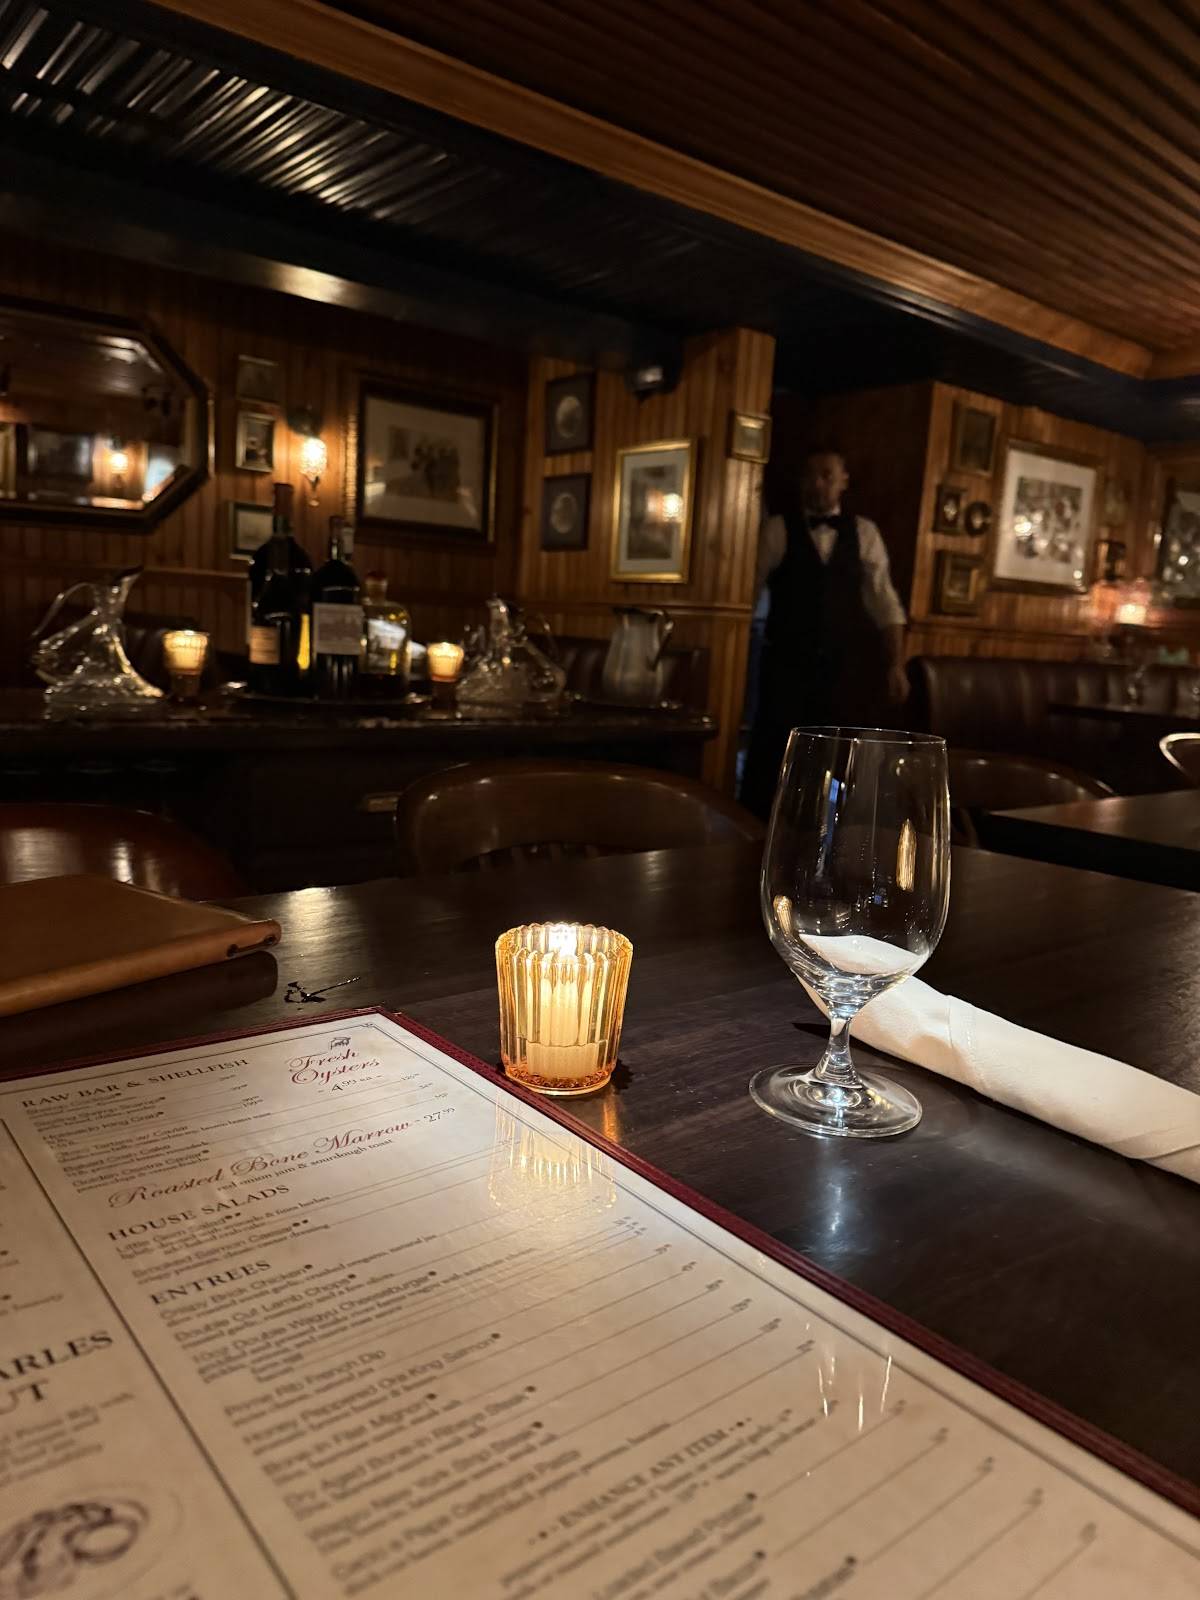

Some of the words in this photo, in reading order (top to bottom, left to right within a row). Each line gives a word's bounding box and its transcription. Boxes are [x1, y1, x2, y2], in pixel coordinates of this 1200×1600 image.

[285, 1047, 360, 1074] Fresh
[290, 1058, 381, 1086] Oysters
[21, 1092, 71, 1109] RAW
[77, 1083, 120, 1097] BAR
[126, 1079, 145, 1088] &
[148, 1059, 248, 1083] SHELLFISH
[108, 1168, 223, 1208] Roasted
[231, 1150, 309, 1177] Bone
[312, 1122, 410, 1155] Marrow
[108, 1211, 197, 1241] HOUSE
[201, 1184, 291, 1214] SALADS
[150, 1259, 272, 1305] ENTREES
[358, 1350, 386, 1365] Dip
[407, 1360, 444, 1377] King
[442, 1336, 496, 1363] Salmon
[558, 1474, 646, 1528] ENHANCE
[649, 1452, 686, 1476] ANY
[684, 1428, 730, 1457] ITEM
